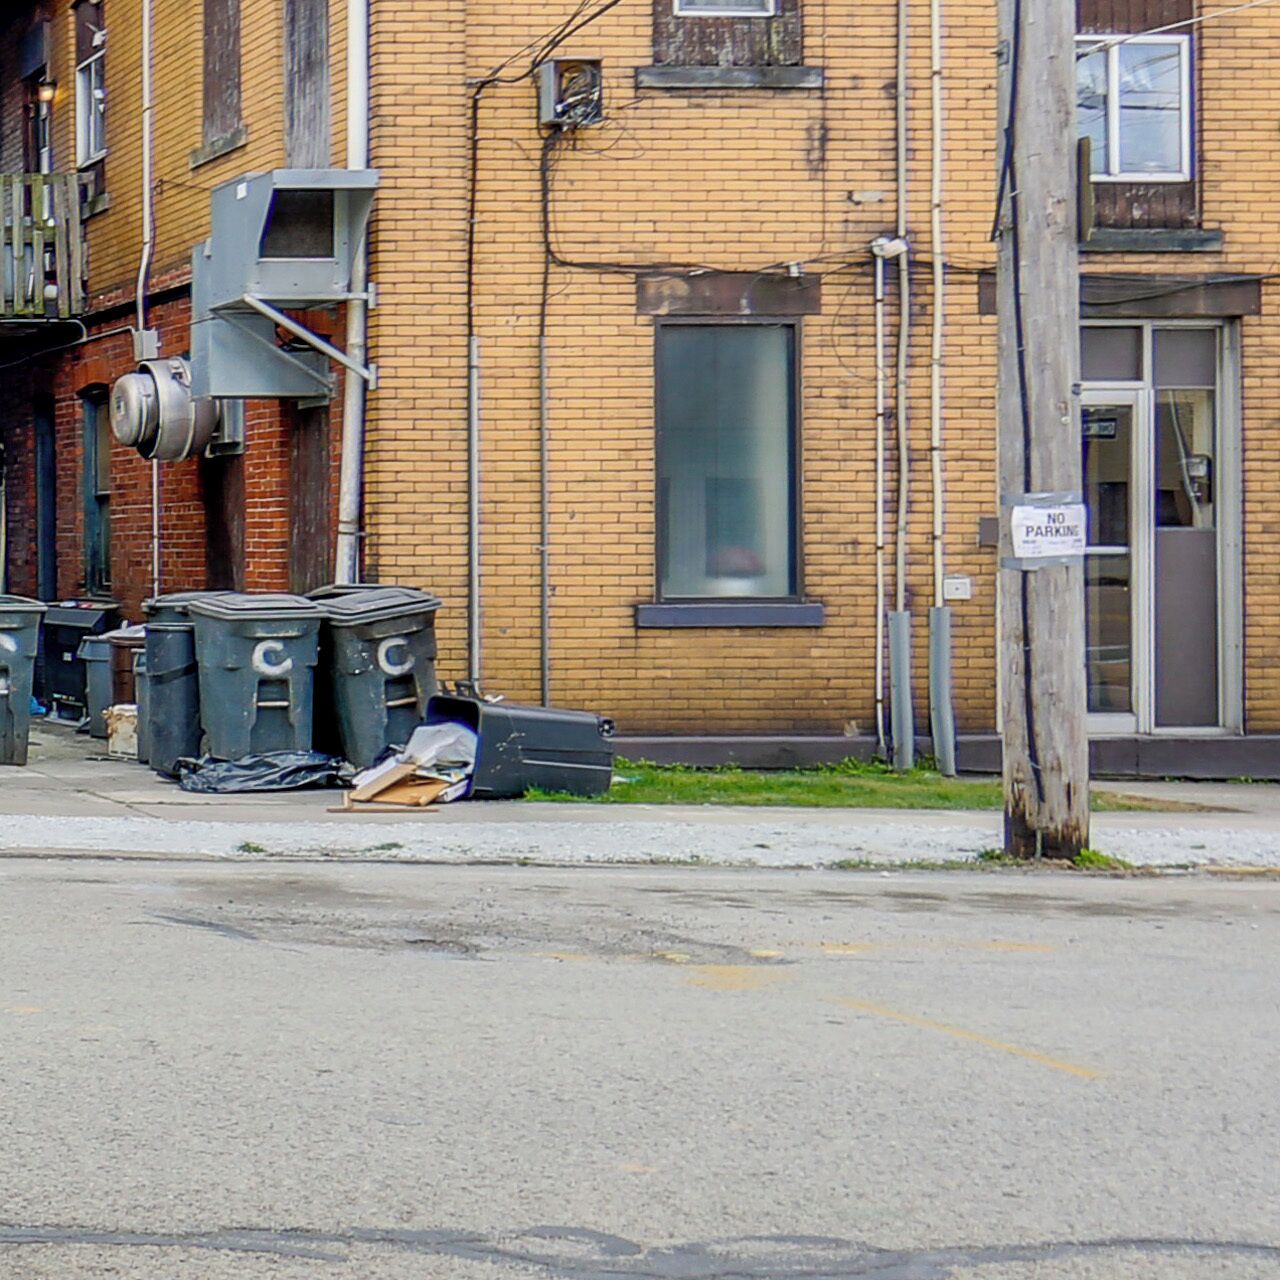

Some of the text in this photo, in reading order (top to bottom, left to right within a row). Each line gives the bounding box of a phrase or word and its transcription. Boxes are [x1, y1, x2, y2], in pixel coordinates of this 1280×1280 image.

[1047, 512, 1066, 525] NO
[252, 639, 293, 676] C
[377, 637, 416, 676] C
